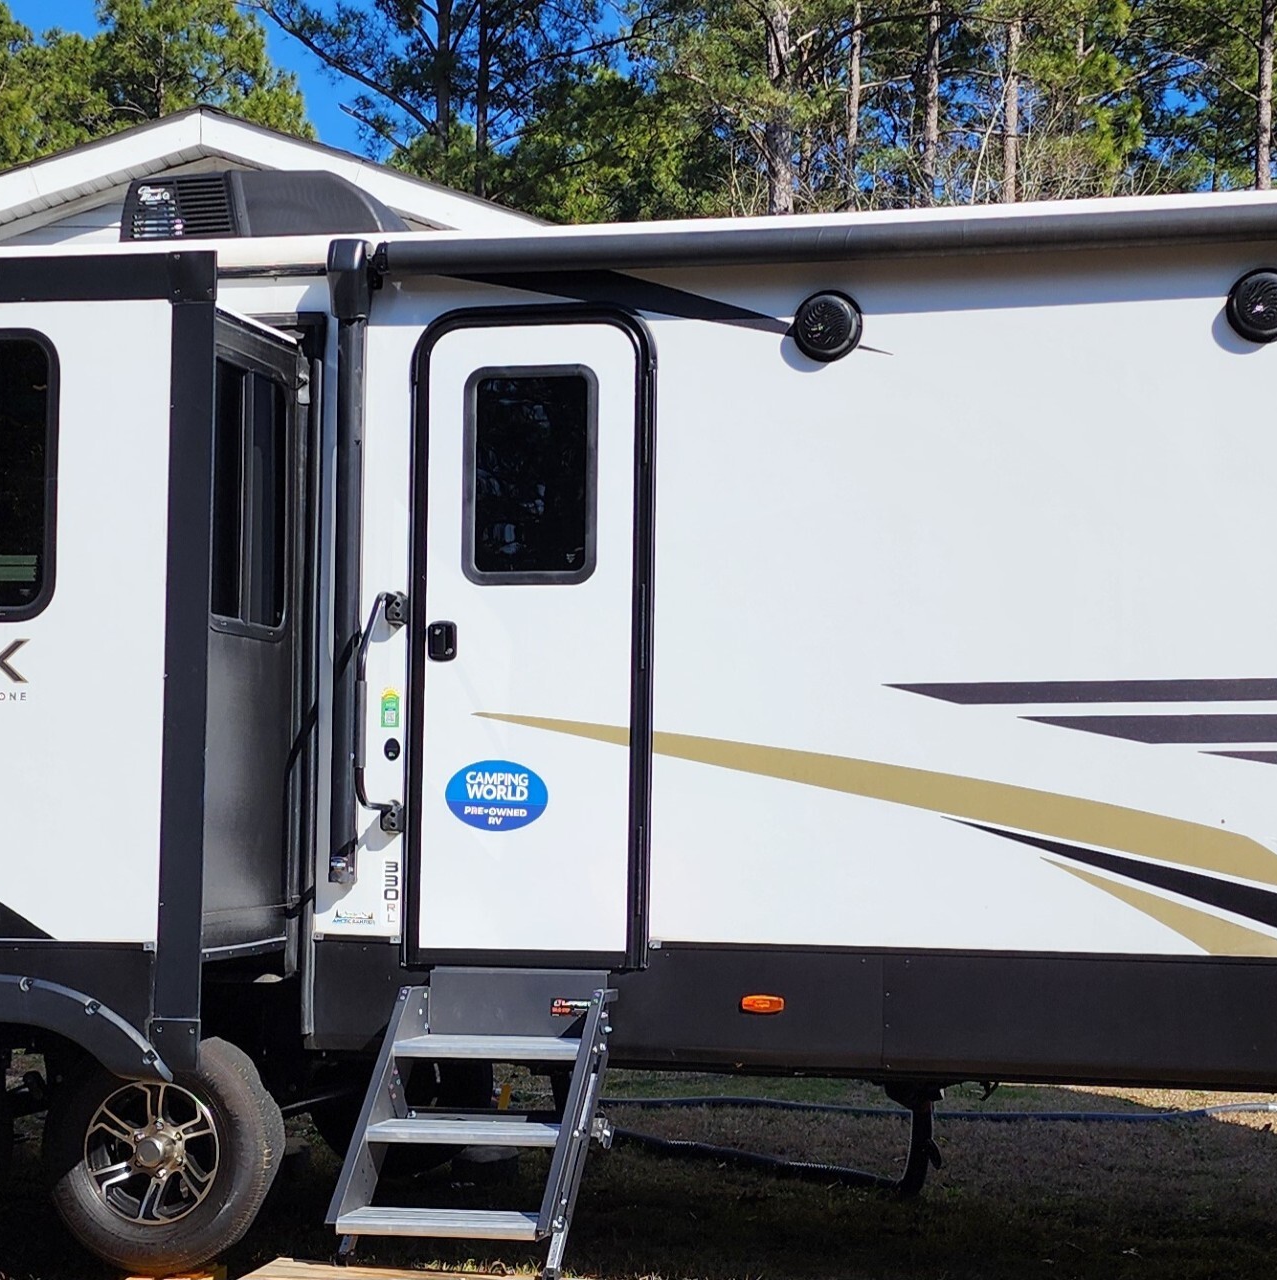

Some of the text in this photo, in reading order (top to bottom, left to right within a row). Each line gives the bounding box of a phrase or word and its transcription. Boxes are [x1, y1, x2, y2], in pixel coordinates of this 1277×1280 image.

[465, 771, 529, 786] CAMPING
[466, 783, 528, 801] WORLD
[488, 817, 502, 825] RV
